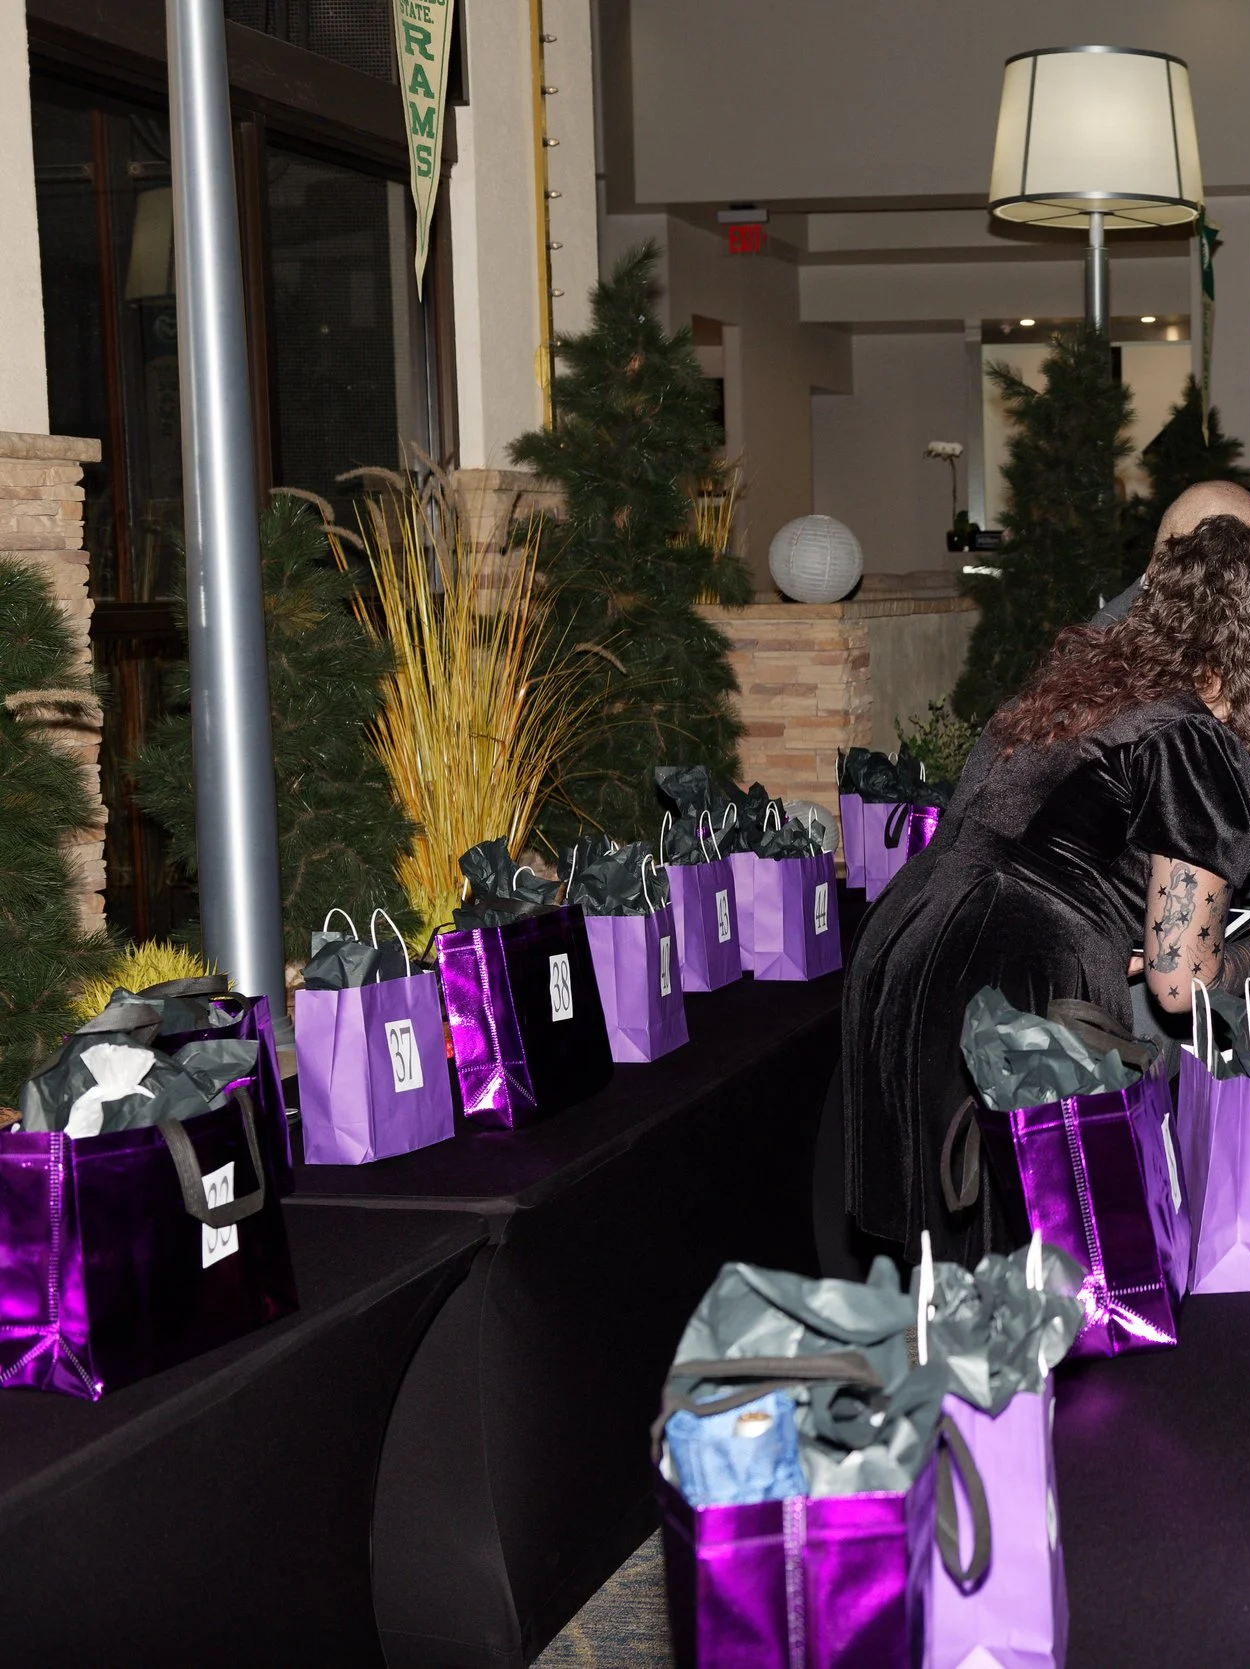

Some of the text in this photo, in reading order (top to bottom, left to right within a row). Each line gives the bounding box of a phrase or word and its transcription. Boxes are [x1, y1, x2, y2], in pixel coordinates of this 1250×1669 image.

[402, 19, 435, 178] RAMS
[728, 224, 762, 254] EXIT
[719, 896, 729, 937] 43
[815, 889, 827, 929] 44
[552, 960, 570, 1012] 38
[389, 1026, 412, 1083] 37
